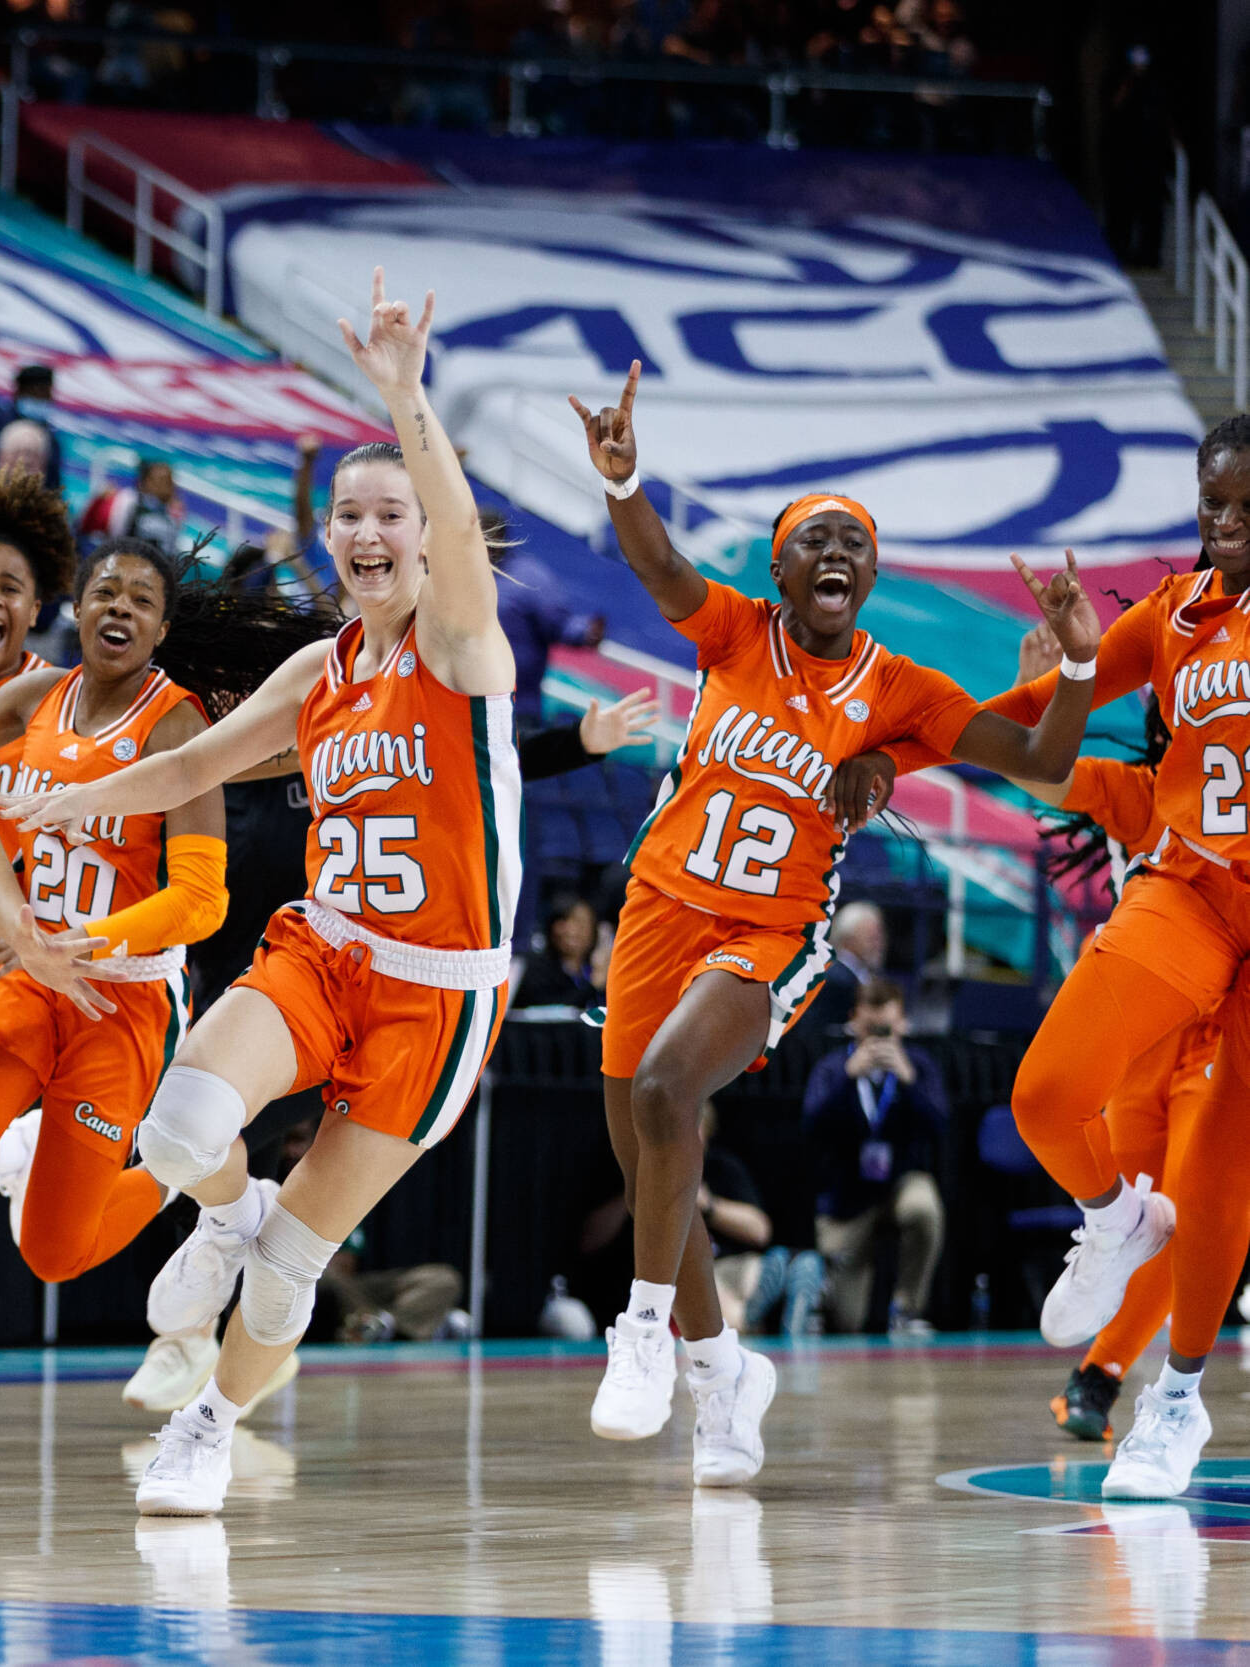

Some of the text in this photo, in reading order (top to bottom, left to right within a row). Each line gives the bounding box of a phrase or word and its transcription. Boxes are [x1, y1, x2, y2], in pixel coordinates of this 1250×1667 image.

[434, 298, 1168, 379] ACC
[311, 722, 433, 818] Miami
[1201, 743, 1250, 836] 2
[28, 831, 118, 929] 20
[314, 815, 428, 914] 25
[684, 788, 797, 897] 12
[706, 949, 755, 972] Canes
[74, 1101, 122, 1142] Canes
